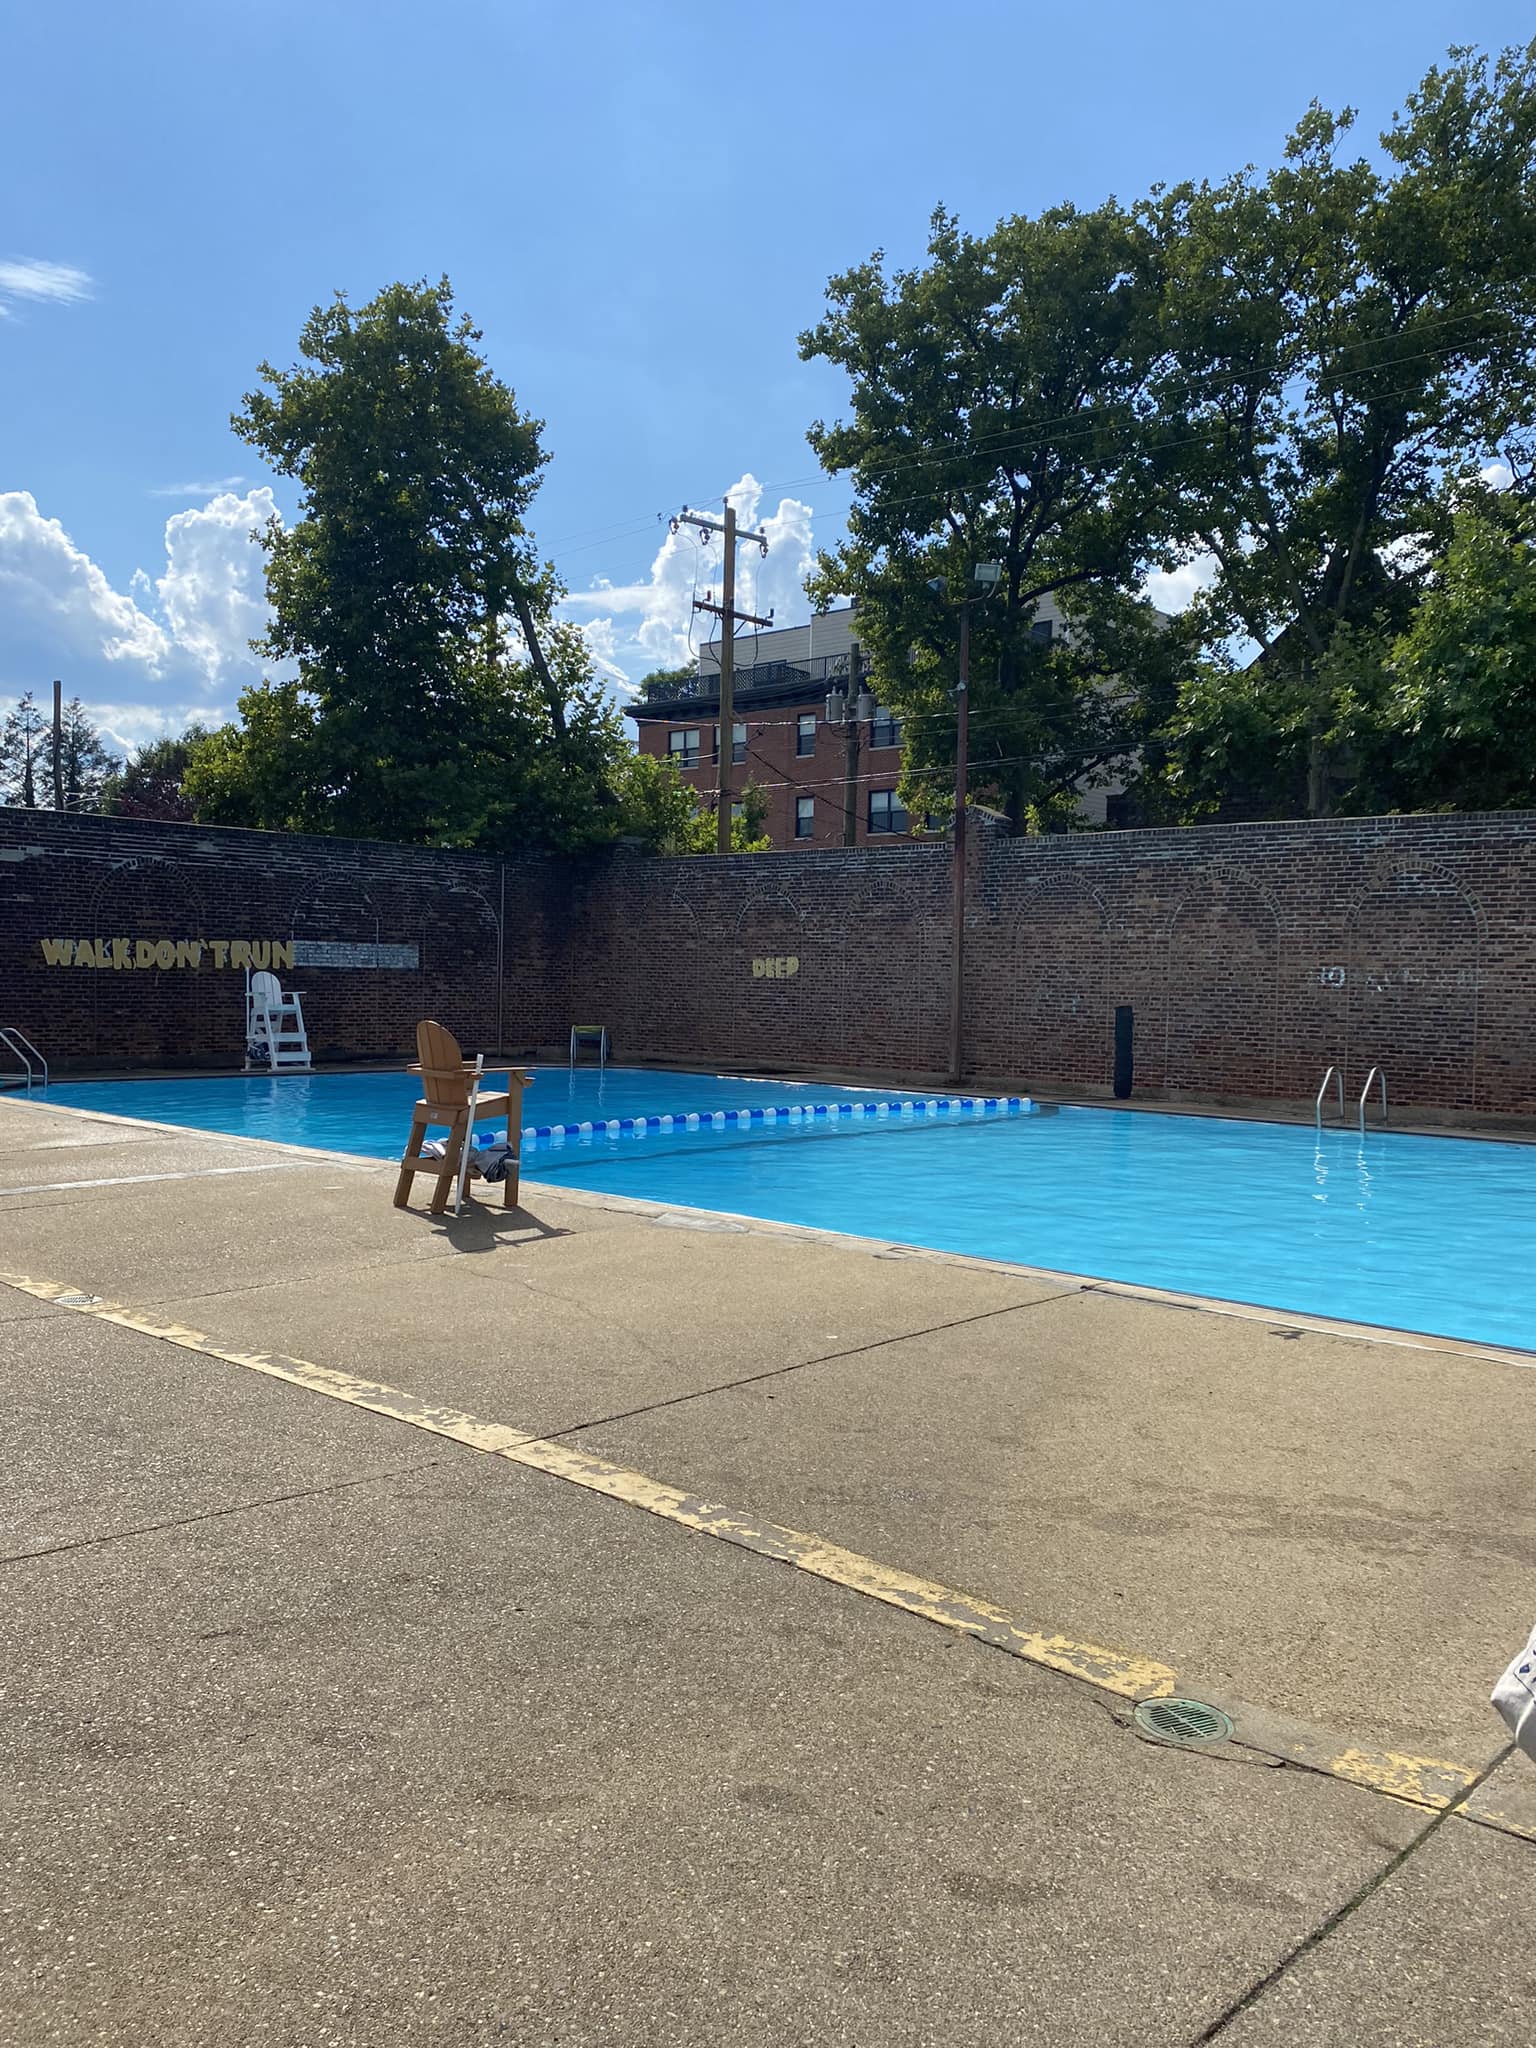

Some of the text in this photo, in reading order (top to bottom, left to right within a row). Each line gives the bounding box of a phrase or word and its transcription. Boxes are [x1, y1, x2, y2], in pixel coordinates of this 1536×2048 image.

[230, 940, 294, 970] RUN
[752, 955, 799, 978] DEEP
[1268, 1330, 1305, 1341] 4
